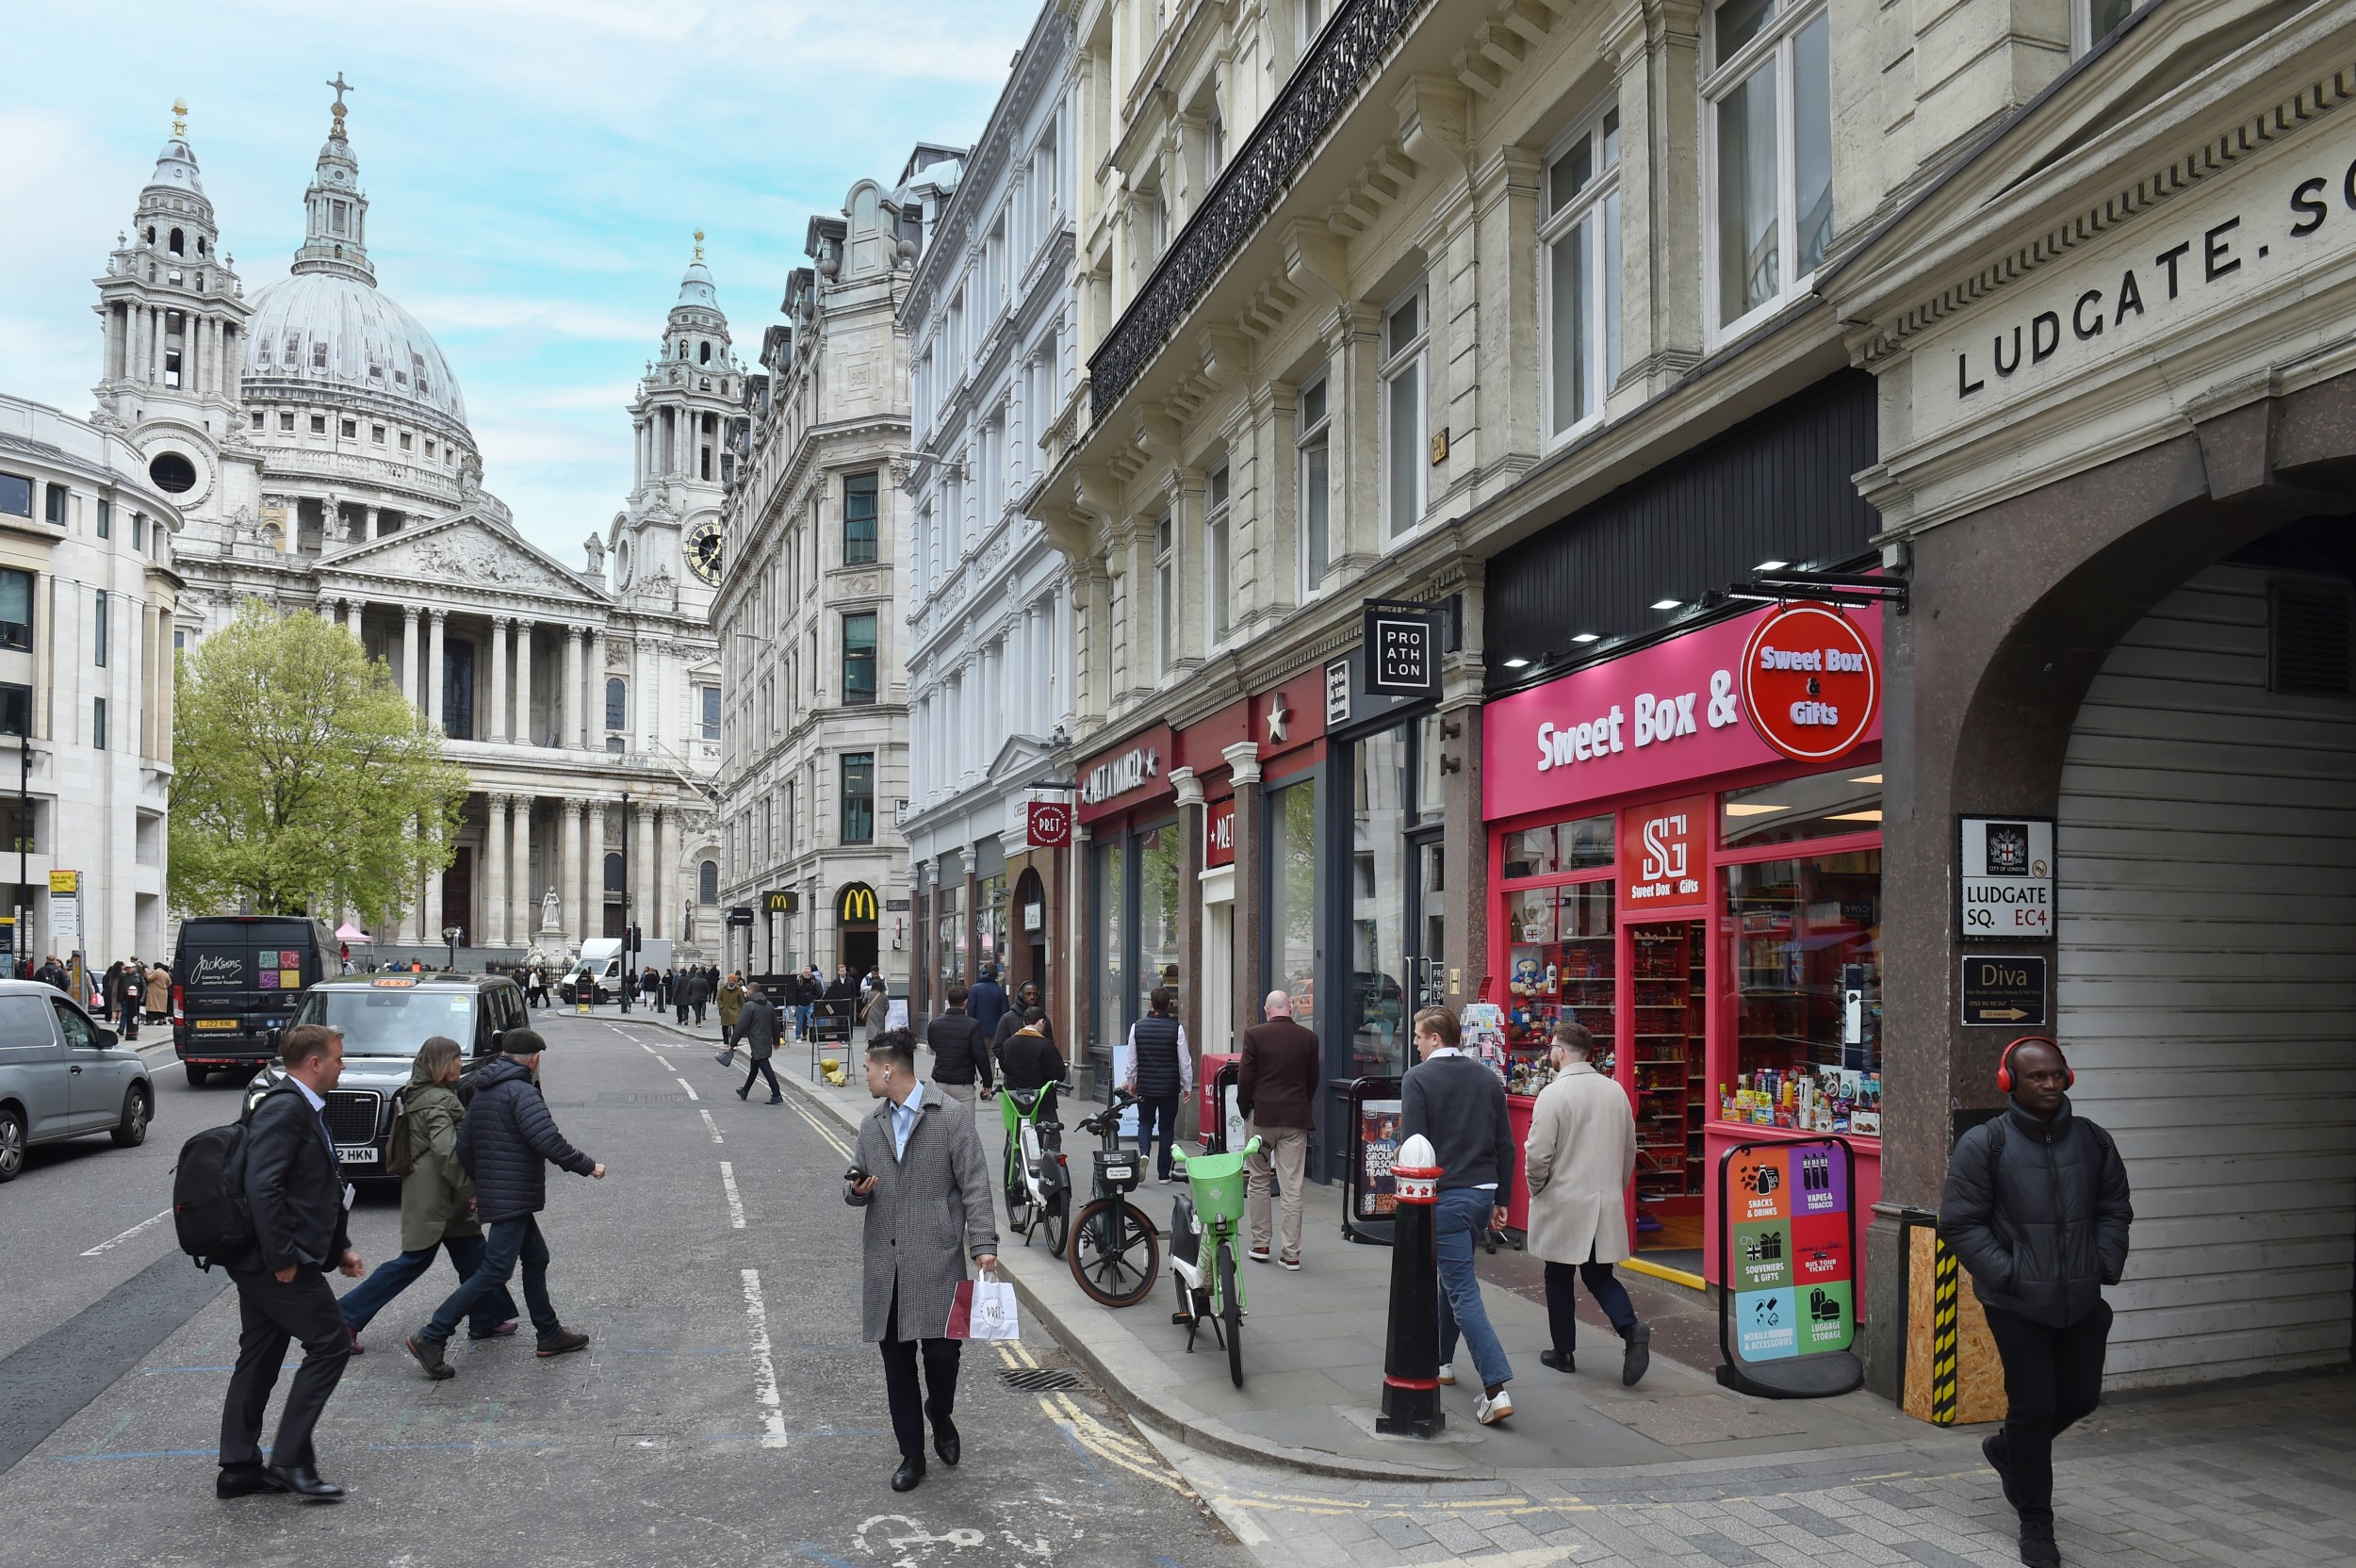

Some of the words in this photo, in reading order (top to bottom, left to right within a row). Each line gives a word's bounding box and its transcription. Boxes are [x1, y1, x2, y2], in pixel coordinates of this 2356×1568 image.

[1387, 631, 1420, 645] PRO
[1386, 647, 1420, 660] ATH
[1759, 645, 1822, 672] Sweet
[1824, 649, 1864, 672] Box
[1388, 662, 1420, 677] LON
[1330, 671, 1344, 686] PRO
[1807, 677, 1820, 695] &
[1330, 686, 1345, 701] ATH
[1331, 700, 1345, 714] LON
[1790, 700, 1839, 727] Gifts
[1537, 705, 1625, 772] Sweet
[1634, 691, 1697, 748] Box
[1707, 669, 1739, 728] &
[1089, 764, 1106, 805] PRET
[1113, 747, 1145, 795] MANGER
[1033, 806, 1050, 818] ORGANIC
[1052, 807, 1066, 819] COFFEE
[1039, 818, 1060, 832] PRET
[1217, 813, 1235, 850] PRET
[1032, 827, 1046, 842] FRESHLY
[1631, 884, 1654, 899] Sweet
[1656, 883, 1670, 896] Box
[1679, 879, 1698, 893] Gifts
[1967, 887, 2047, 904] LUDGATE
[1968, 908, 1995, 928] SQ.
[2015, 909, 2047, 926] EC4
[190, 955, 242, 984] Jacksons
[1982, 964, 2027, 987] Diva
[348, 1150, 372, 1160] HKN
[1366, 1152, 1394, 1160] GROUP
[1366, 1160, 1397, 1168] PERSON
[1748, 1198, 1773, 1208] SNACKS
[1808, 1201, 1833, 1210] TOBACCO
[1754, 1207, 1777, 1217] DRINKS
[1745, 1263, 1784, 1274] SOUVENIERS
[1754, 1274, 1759, 1282] &
[1760, 1272, 1779, 1282] GIFTS
[987, 1306, 1000, 1318] PRET
[1811, 1321, 1841, 1332] LUGGAGE
[1743, 1331, 1769, 1341] MOBILE
[1751, 1337, 1792, 1349] ACCESSORIES
[1812, 1331, 1841, 1342] STORAGE
